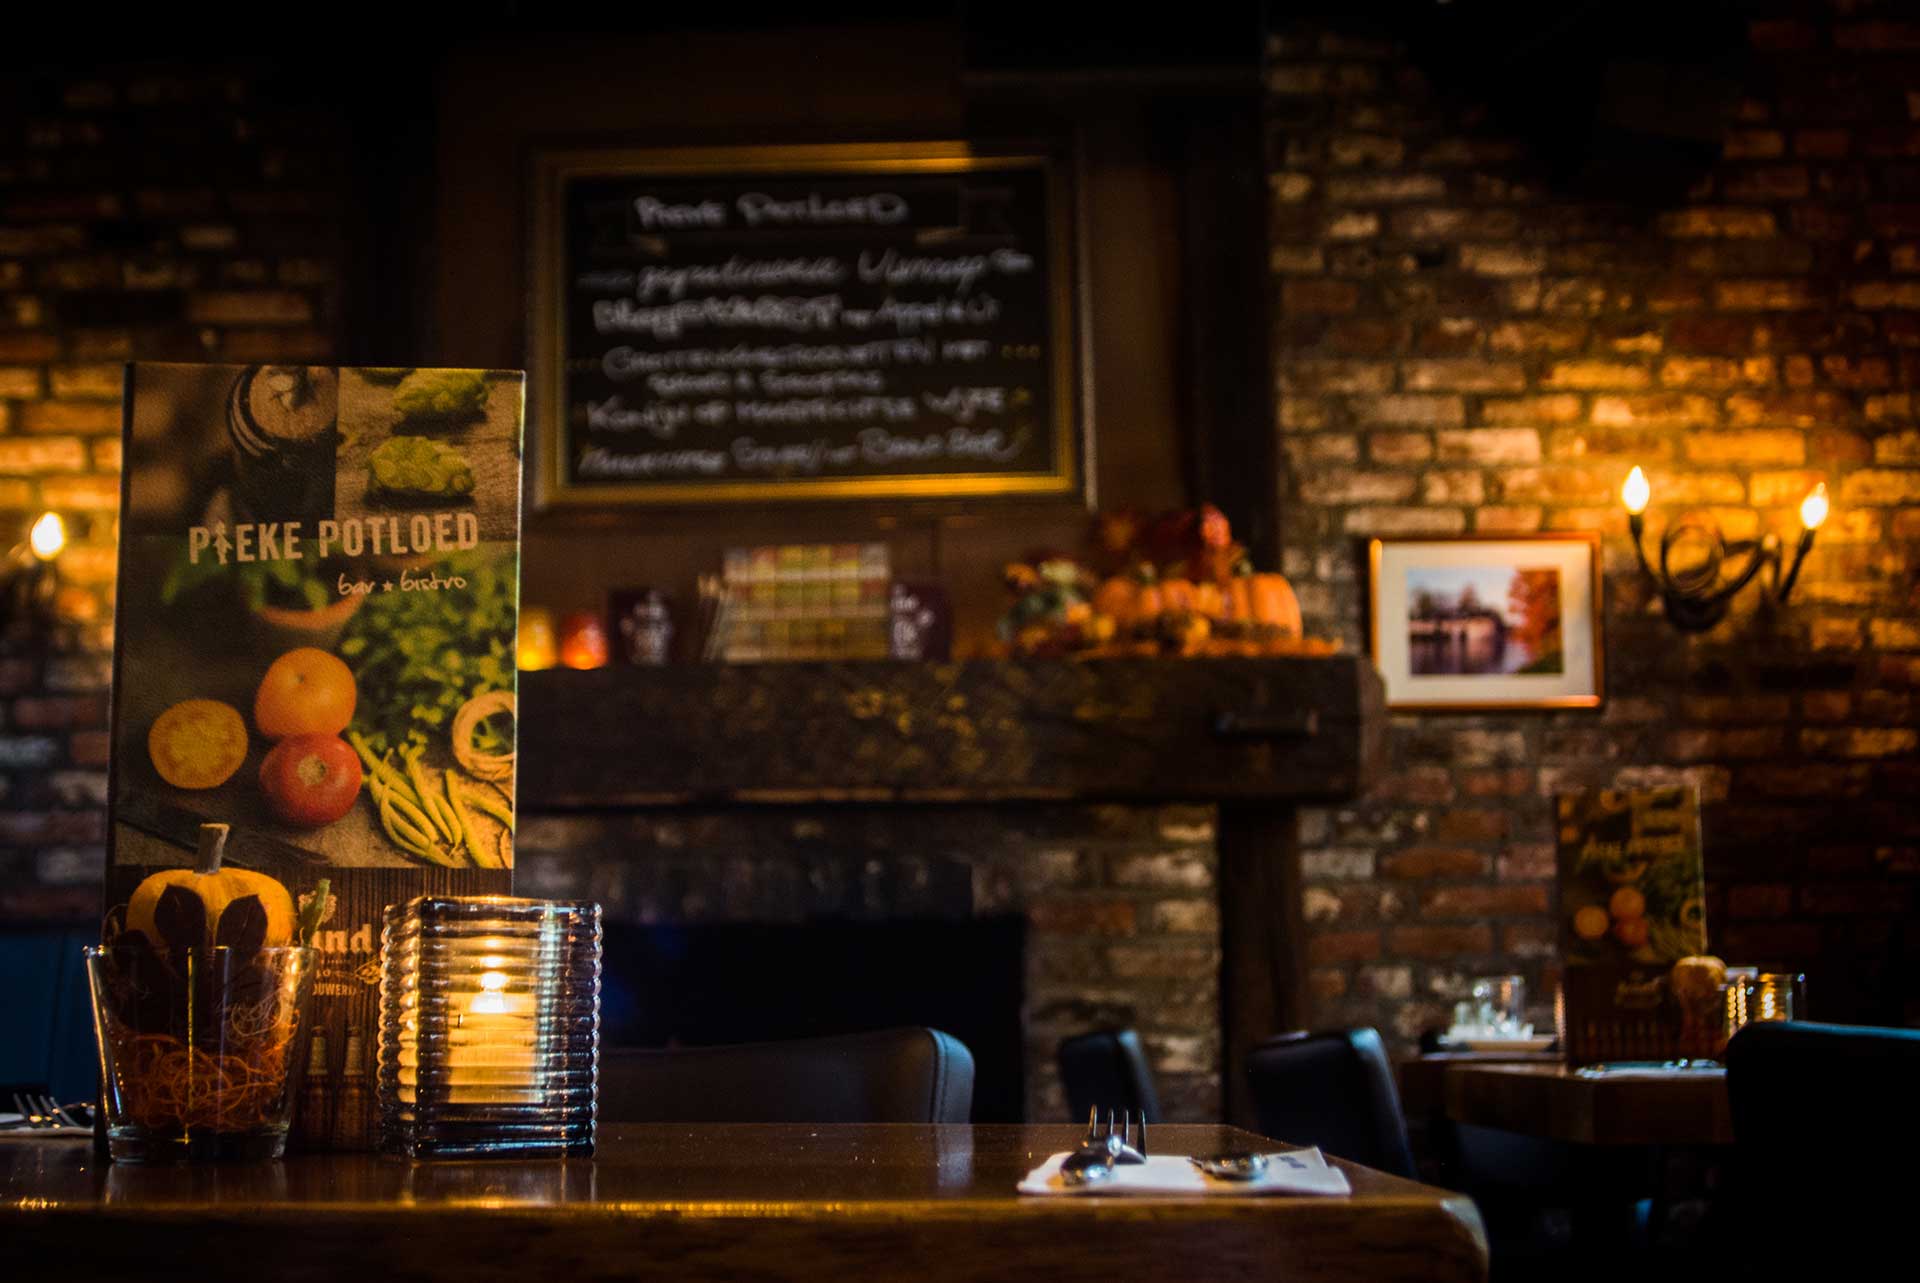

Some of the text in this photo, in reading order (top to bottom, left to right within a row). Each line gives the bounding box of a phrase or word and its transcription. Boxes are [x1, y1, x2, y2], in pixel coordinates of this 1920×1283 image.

[318, 512, 479, 558] POTLOED
[337, 566, 469, 596] bar bistro
